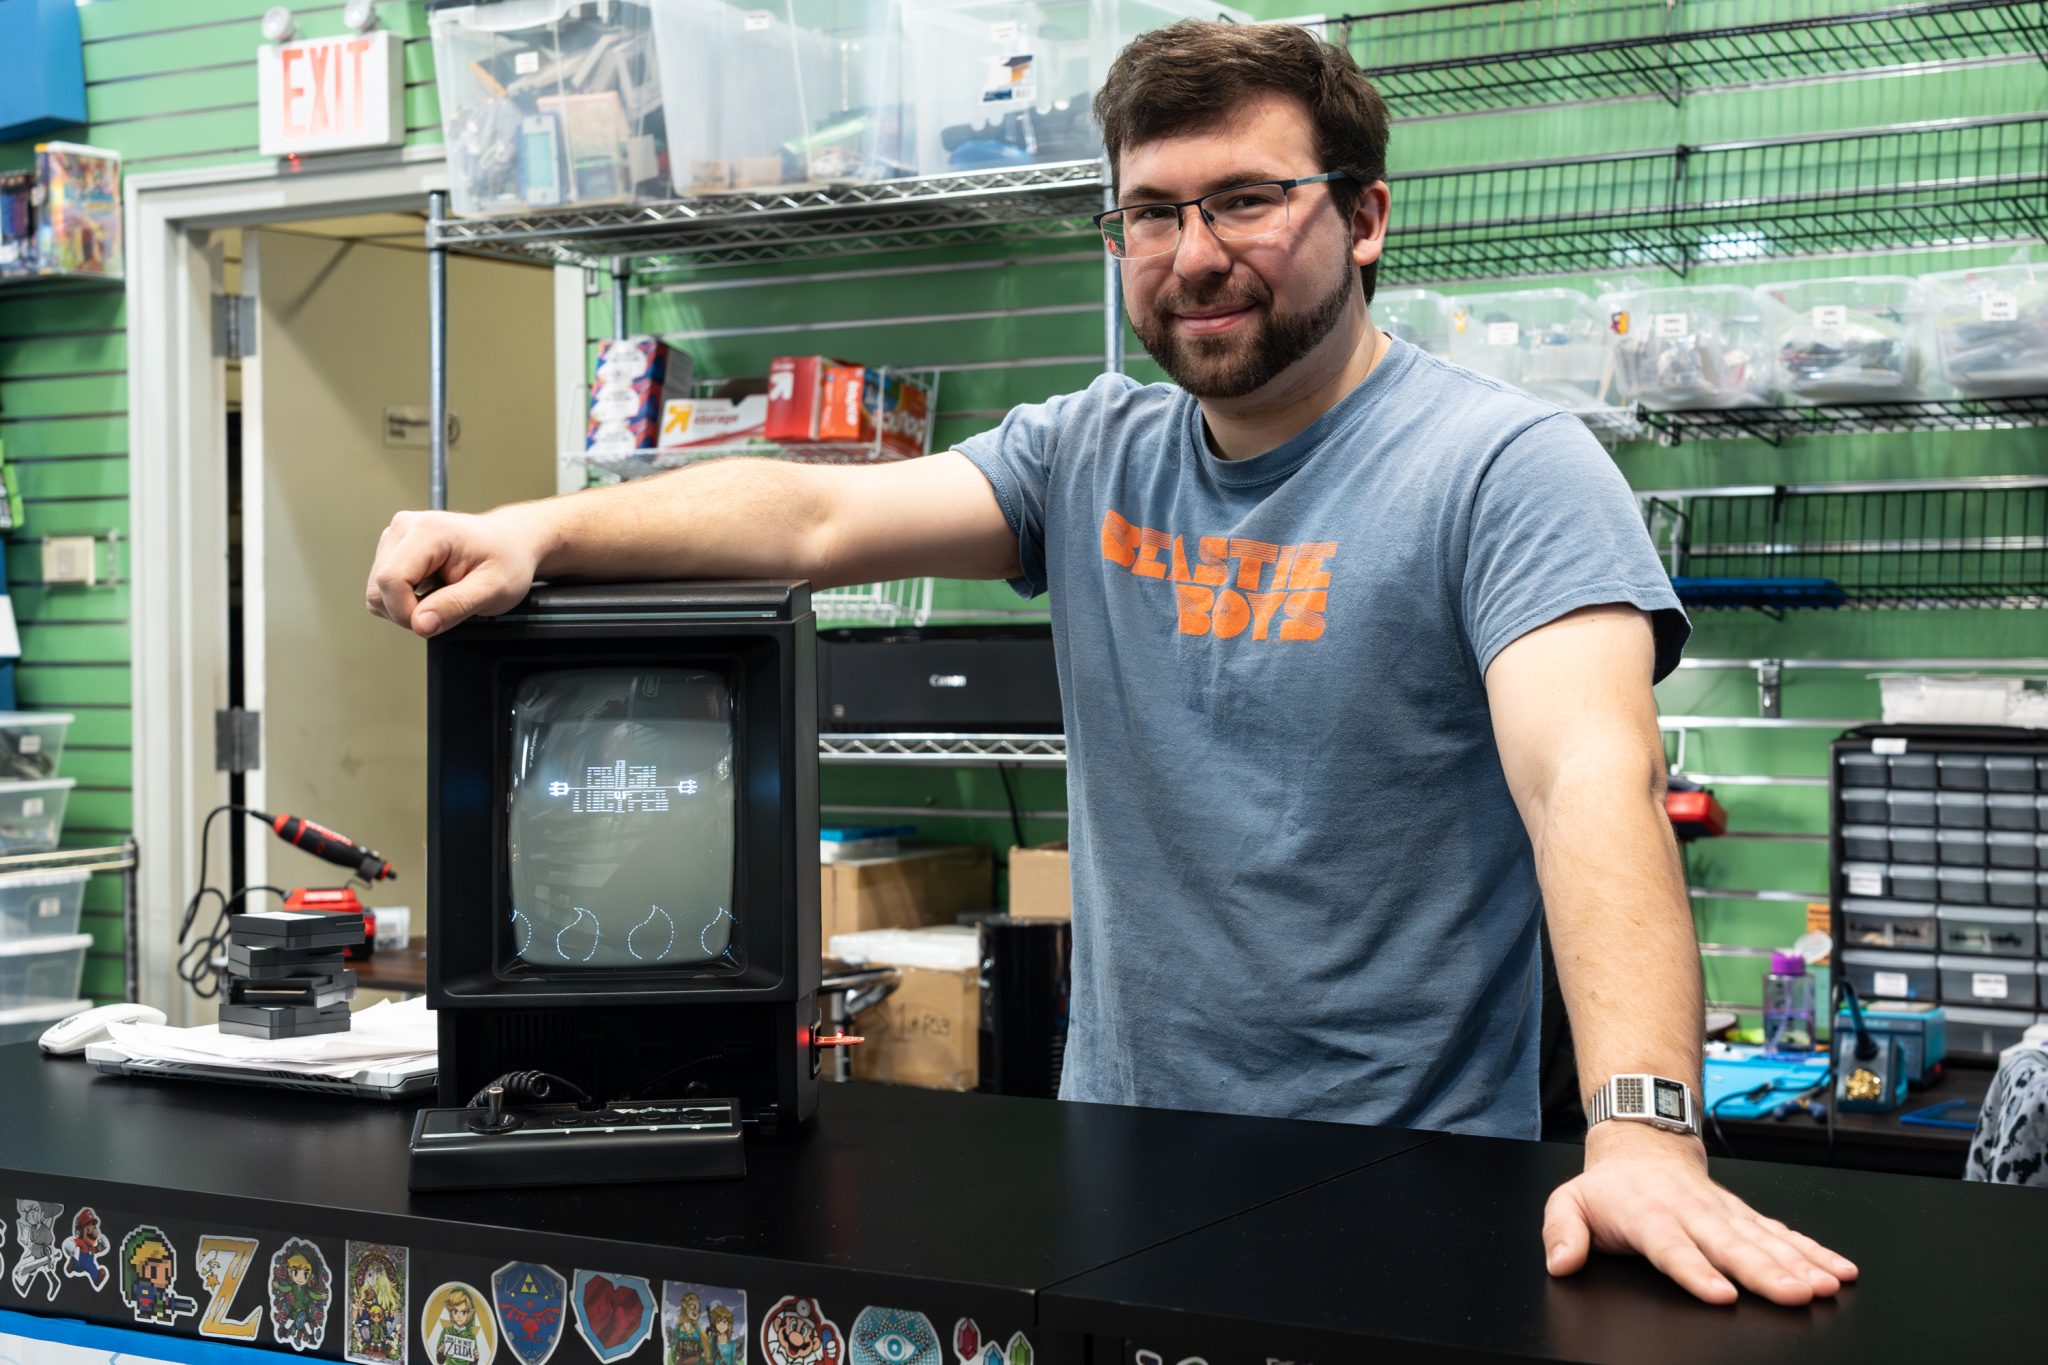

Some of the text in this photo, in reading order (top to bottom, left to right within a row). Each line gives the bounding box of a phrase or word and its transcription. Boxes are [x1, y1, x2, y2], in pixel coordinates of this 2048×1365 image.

[281, 39, 370, 138] EXIT
[1101, 508, 1339, 591] BEASTIE
[1175, 584, 1326, 641] BOYS
[929, 673, 967, 688] Canon
[200, 1238, 261, 1338] Z
[446, 1341, 472, 1359] ZELDA
